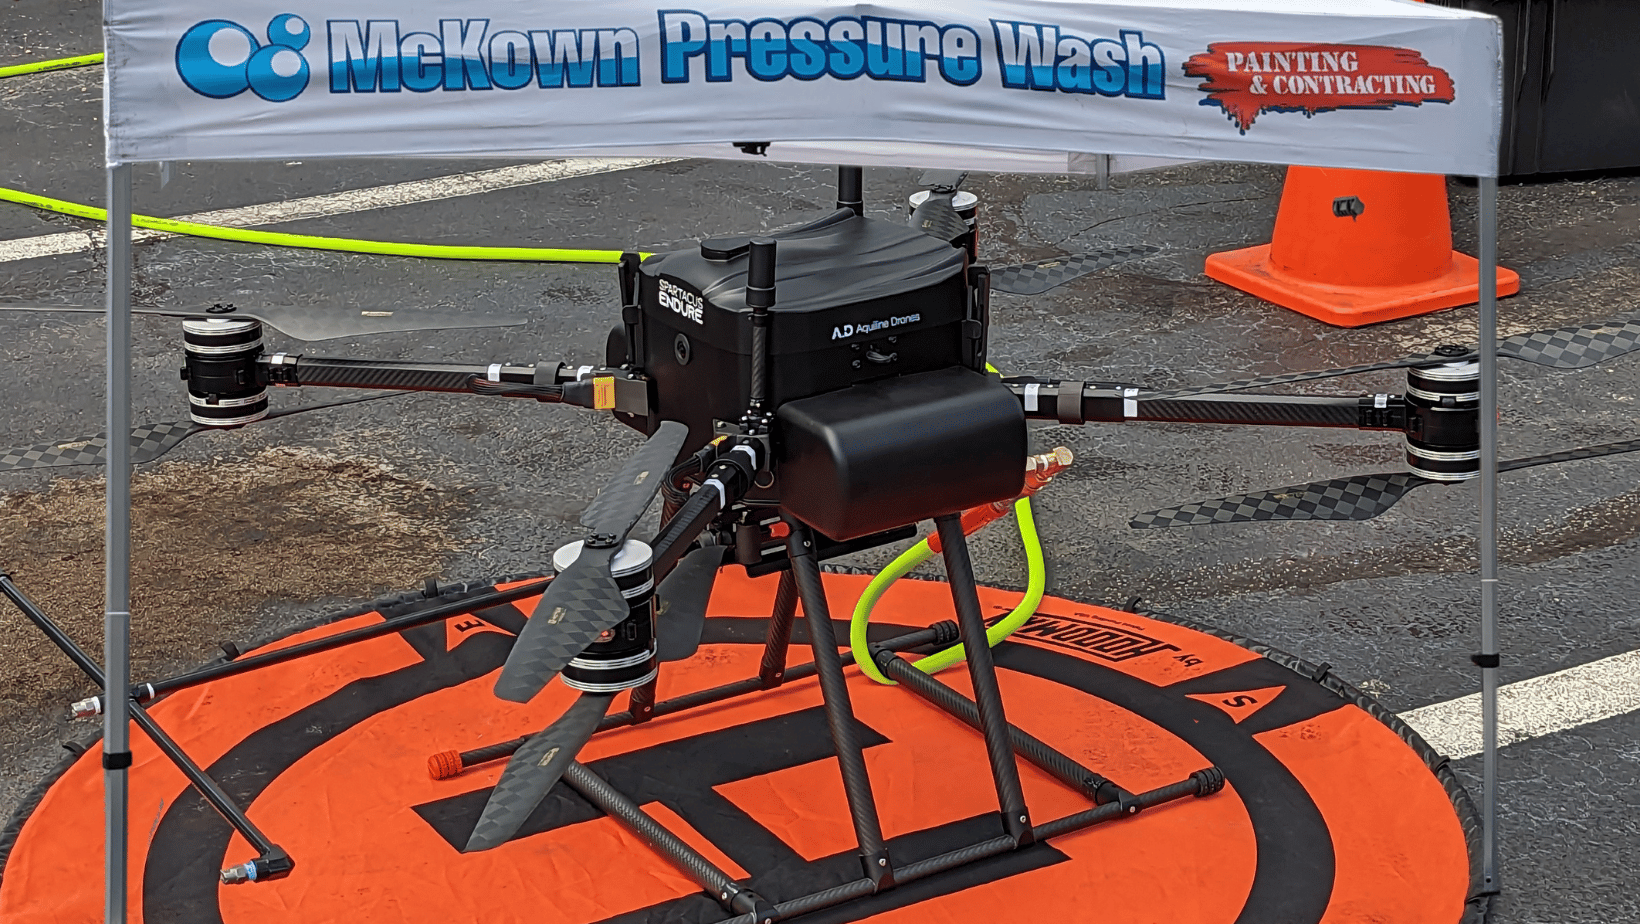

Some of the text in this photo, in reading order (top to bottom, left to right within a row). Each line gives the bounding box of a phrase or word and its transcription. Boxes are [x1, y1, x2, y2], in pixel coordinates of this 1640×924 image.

[326, 9, 1166, 100] McKown Pressure Wash
[1225, 51, 1359, 73] PAINTING
[1249, 75, 1436, 95] & CONTRACTING
[659, 279, 704, 310] SPARTACUS
[658, 290, 704, 325] ENDURE
[856, 320, 889, 334] Aquiline
[890, 313, 921, 327] Drones
[454, 619, 486, 633] E
[1172, 653, 1204, 667] by
[1221, 694, 1259, 708] S
